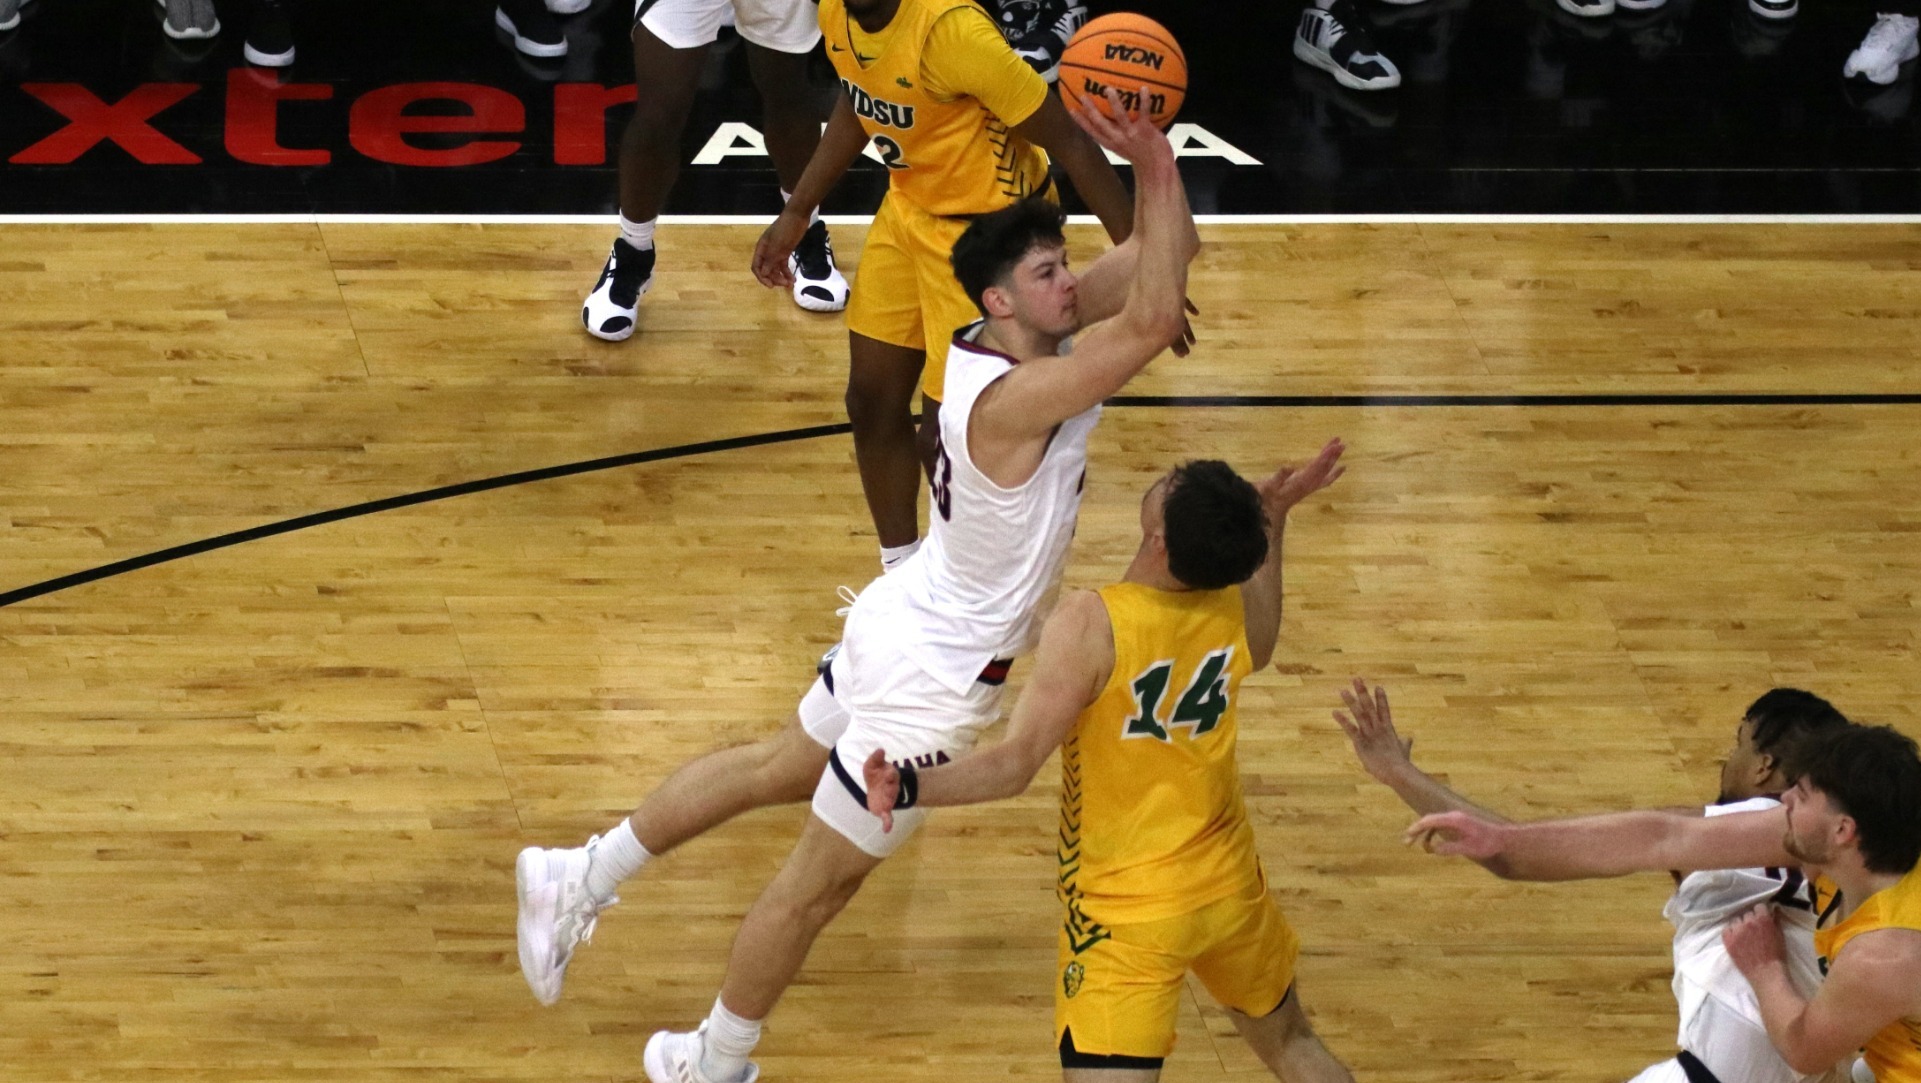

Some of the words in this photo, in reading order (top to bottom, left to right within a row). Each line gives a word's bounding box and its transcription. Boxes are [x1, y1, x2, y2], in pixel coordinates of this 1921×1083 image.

[1104, 43, 1165, 71] NCAA
[871, 133, 912, 170] 2
[1121, 644, 1236, 743] 14
